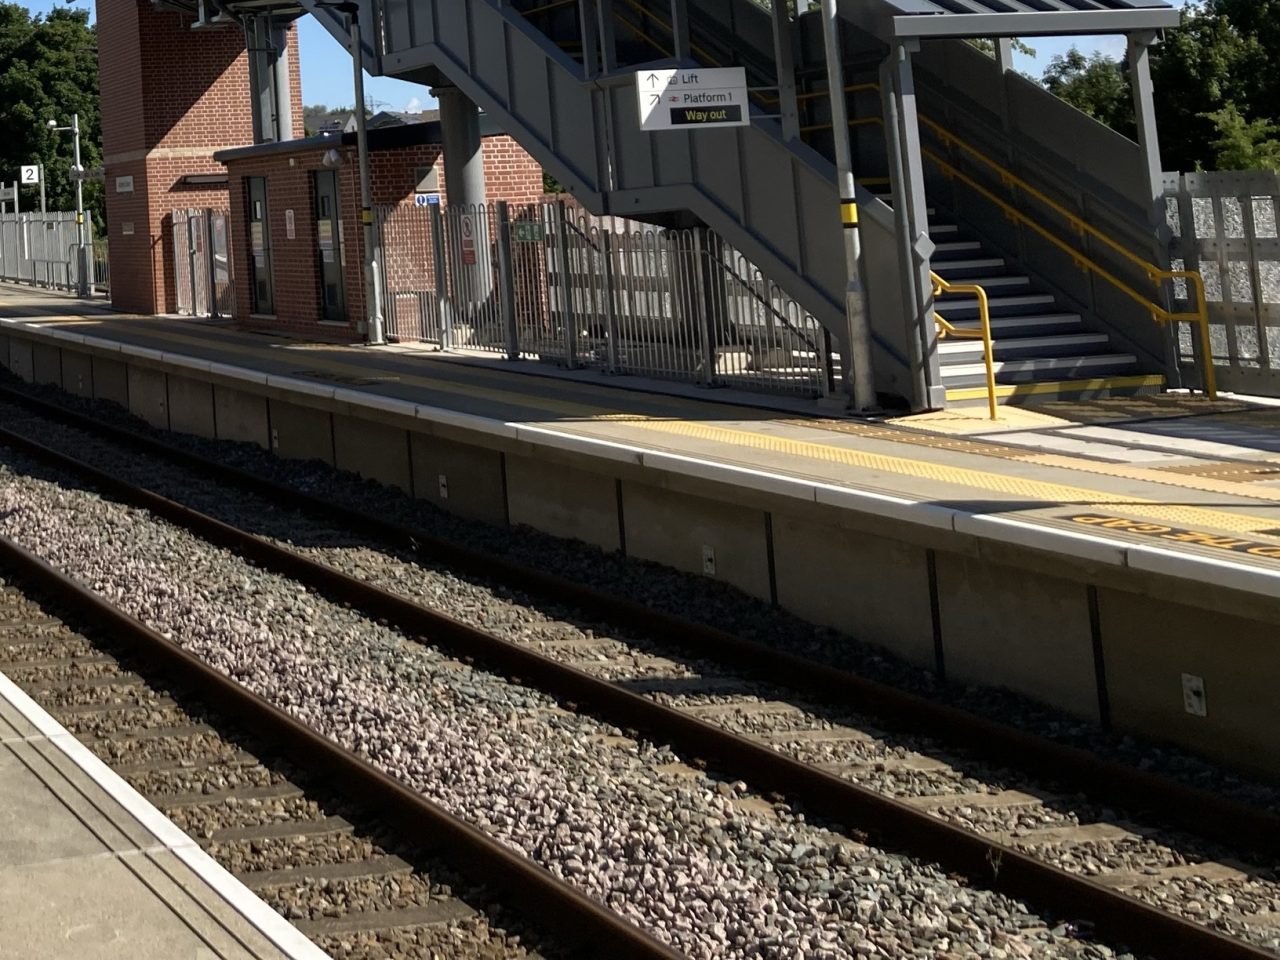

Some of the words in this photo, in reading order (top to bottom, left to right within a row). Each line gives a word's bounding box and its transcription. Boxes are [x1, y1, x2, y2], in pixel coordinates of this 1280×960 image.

[682, 73, 699, 84] Lift
[683, 93, 727, 103] Platform
[728, 92, 733, 101] 1
[685, 110, 708, 122] Way
[710, 110, 727, 119] out
[25, 168, 34, 181] 2
